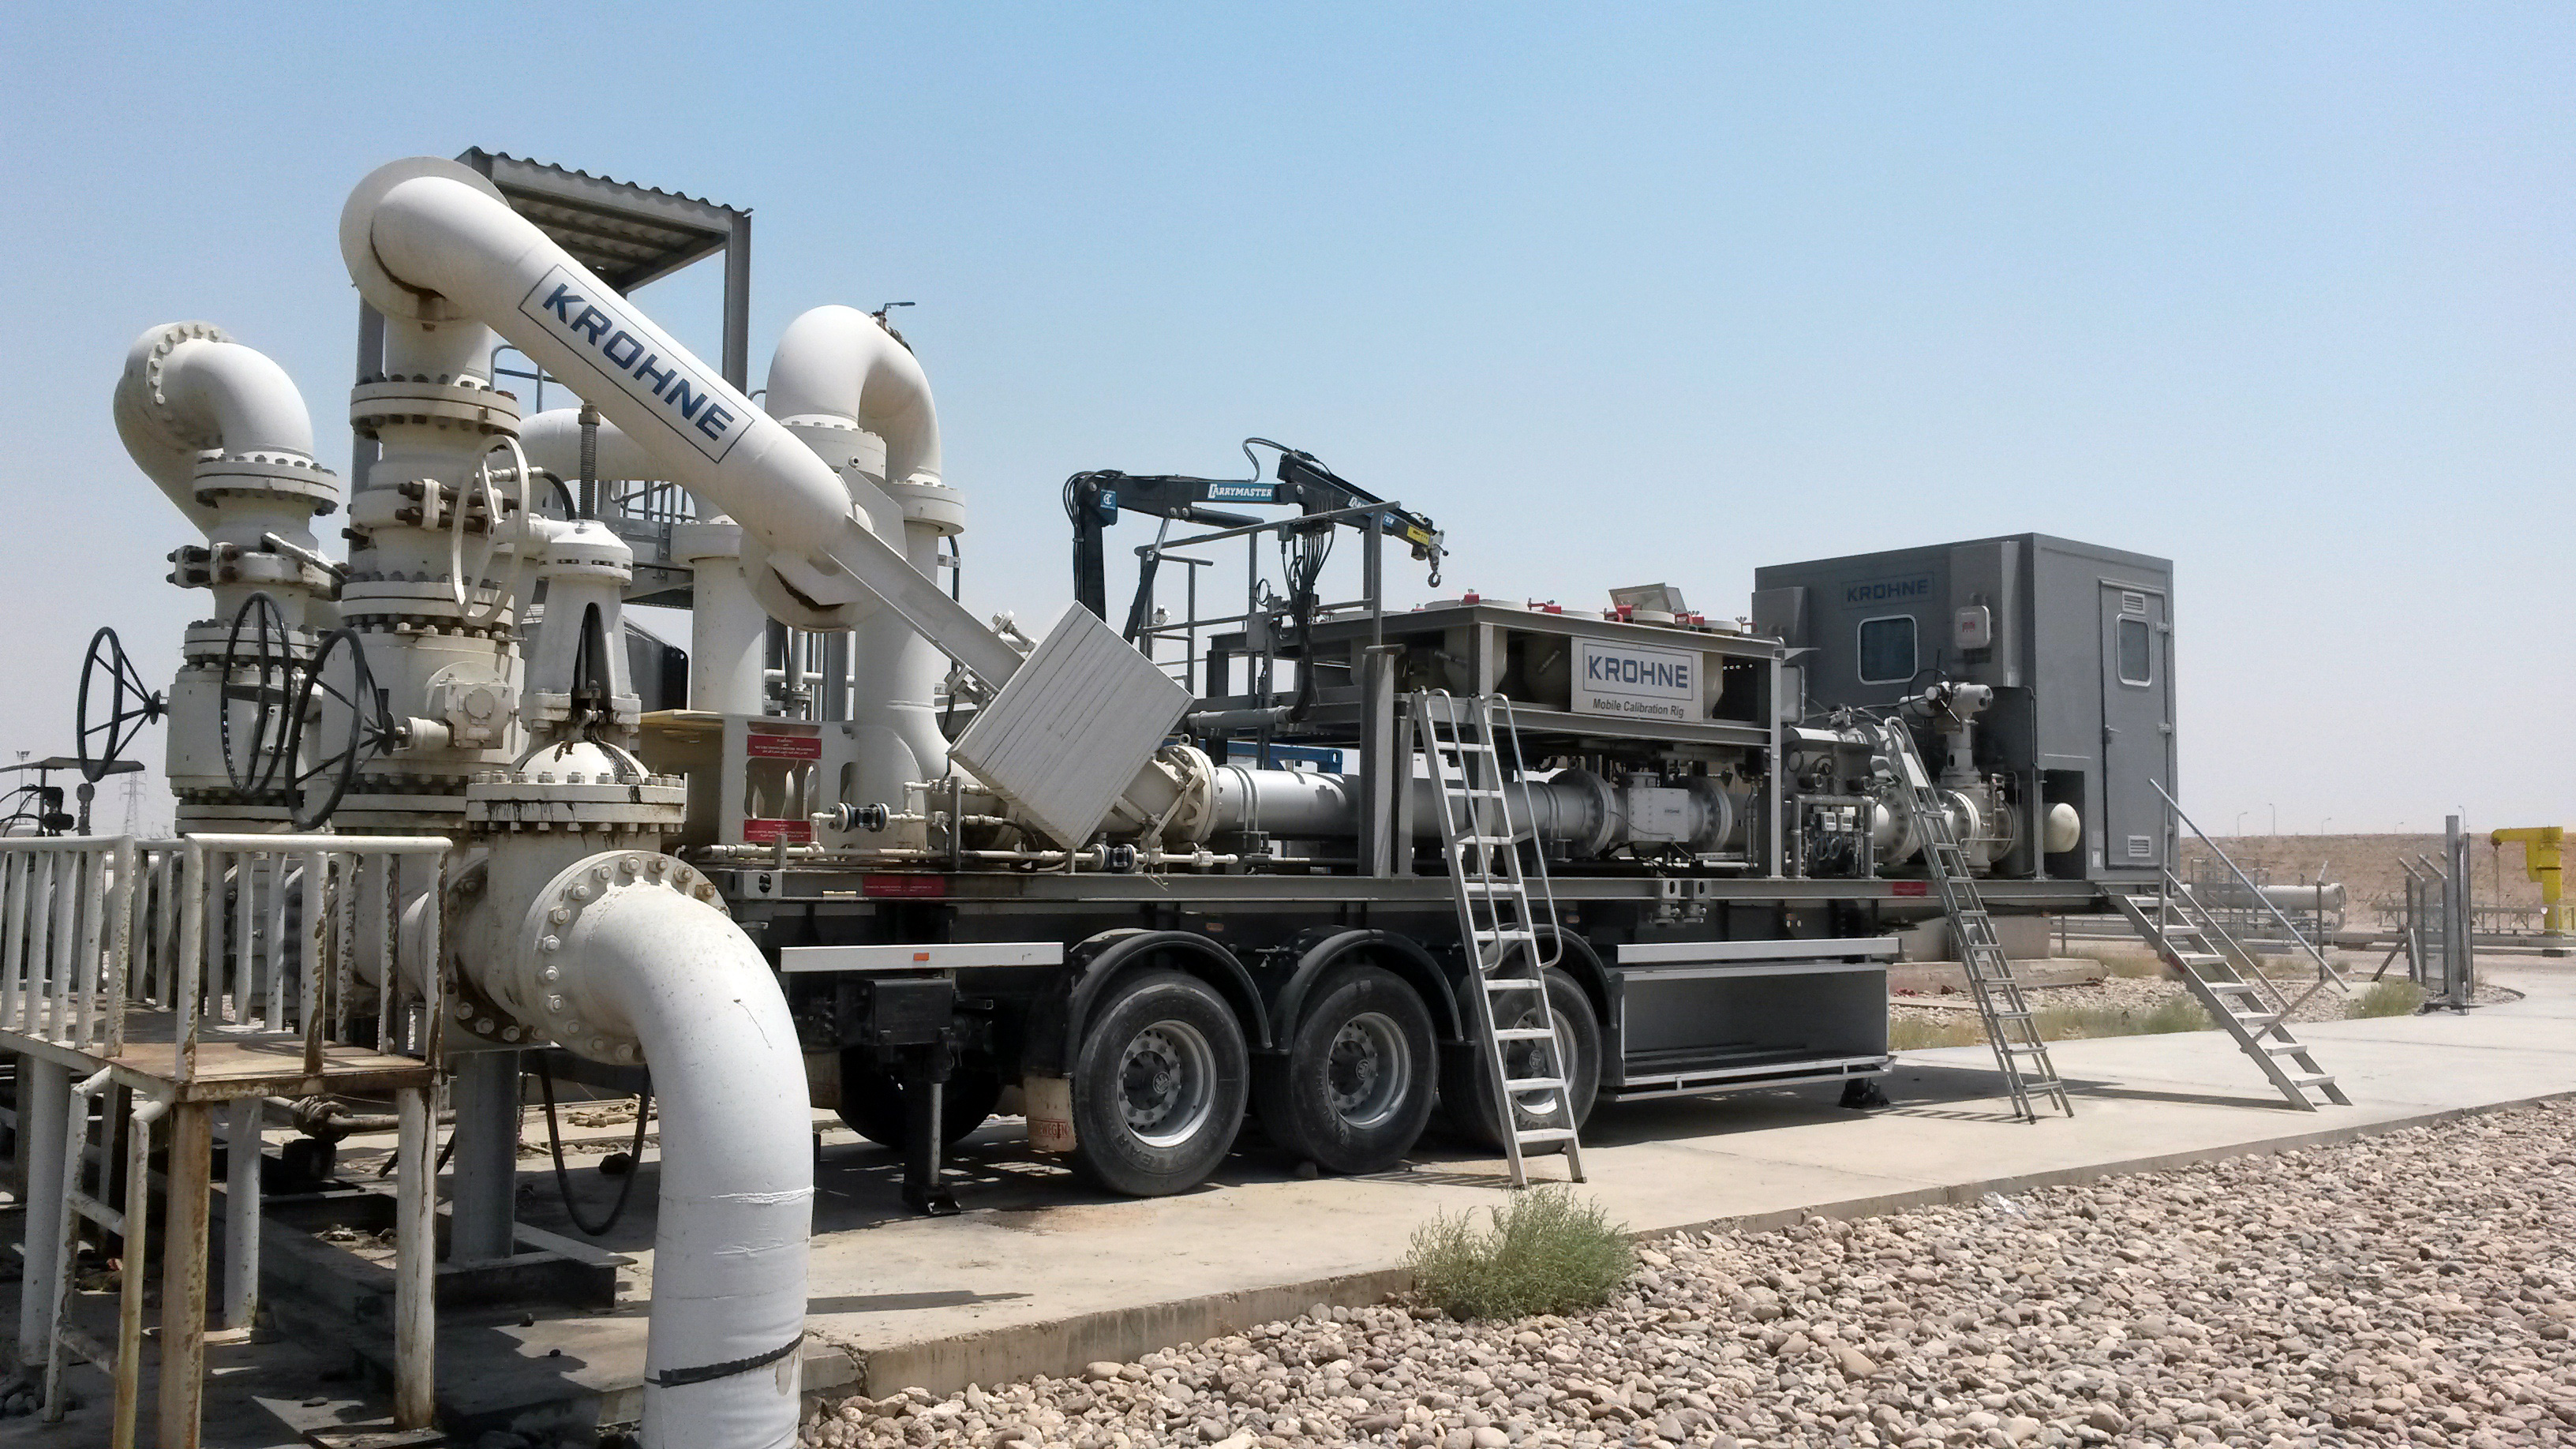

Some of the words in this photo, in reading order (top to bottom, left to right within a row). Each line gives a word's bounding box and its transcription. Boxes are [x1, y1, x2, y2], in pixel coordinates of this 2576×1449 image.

[542, 283, 736, 441] KROHNE
[1208, 483, 1272, 499] CARRYMASTER
[1847, 578, 1929, 602] KROHNE
[1588, 654, 1688, 689] KROHNE
[1593, 698, 1621, 711] Mobile
[1623, 701, 1668, 715] Calibration
[1670, 705, 1685, 719] Rig
